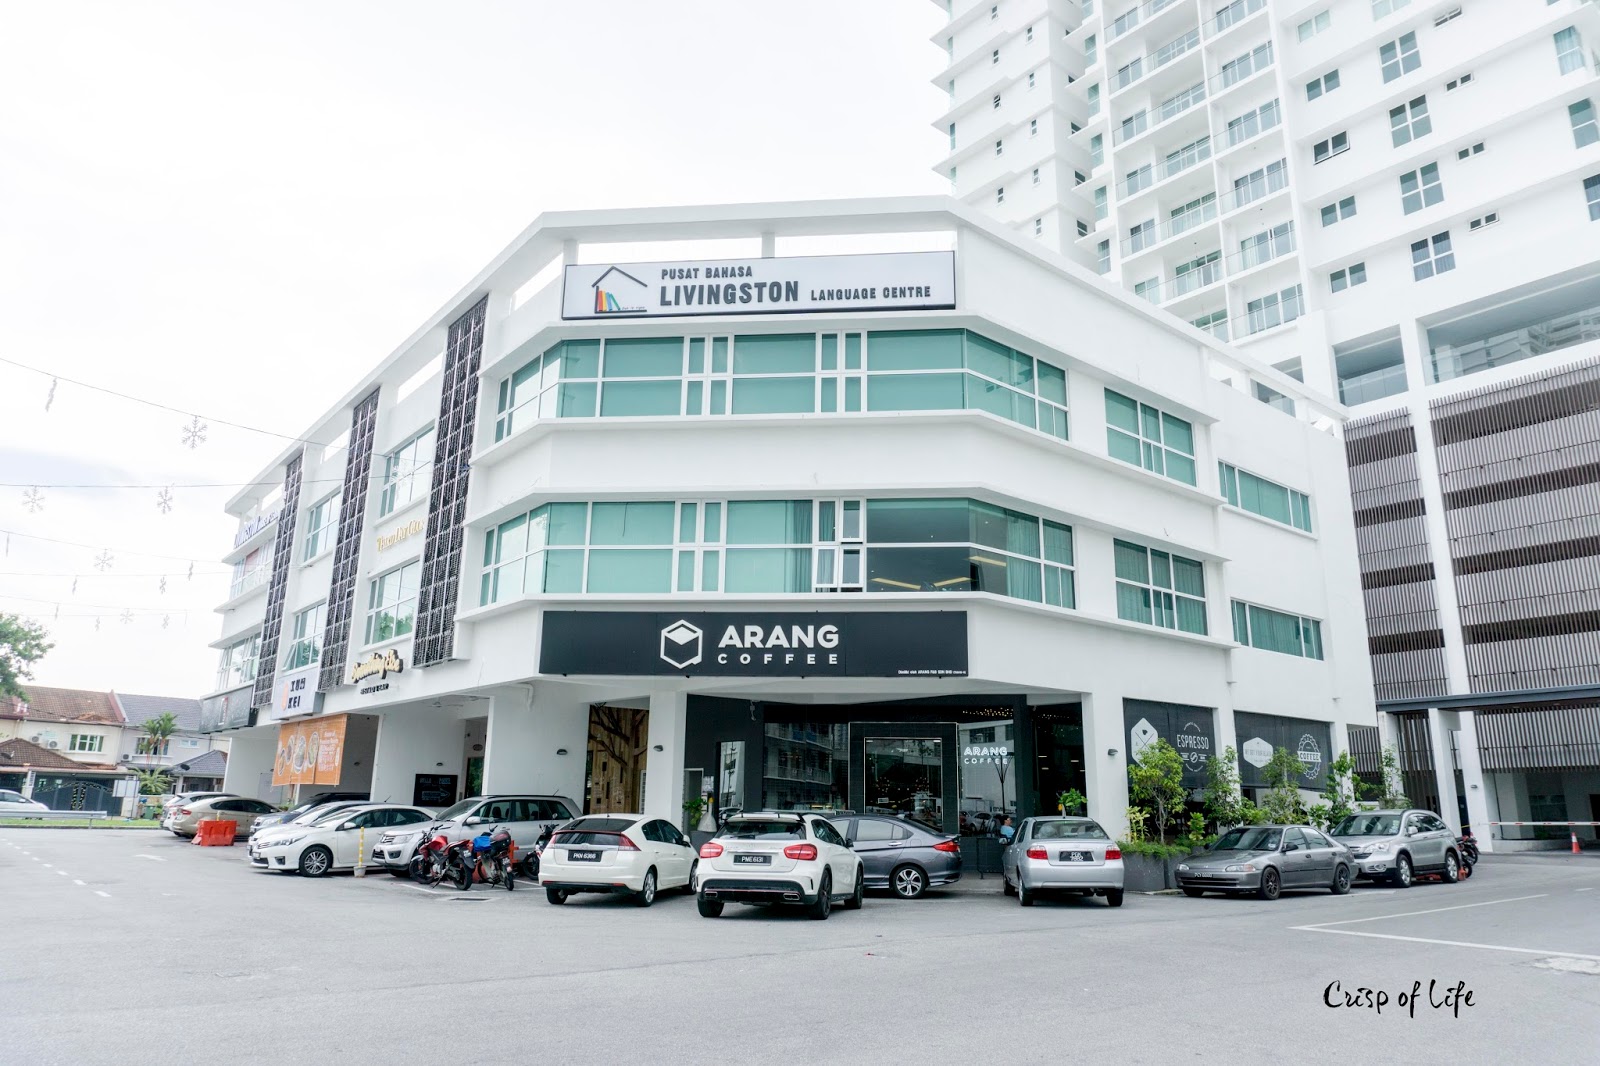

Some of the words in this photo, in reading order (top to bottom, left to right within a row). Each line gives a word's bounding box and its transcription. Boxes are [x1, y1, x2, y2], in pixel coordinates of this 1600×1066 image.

[661, 268, 699, 280] PUSAT
[705, 266, 752, 279] BAHASA
[660, 281, 799, 306] LIVINGSTON
[811, 288, 876, 301] LANGUAGE
[883, 286, 931, 298] CENTRE
[718, 624, 839, 649] ARANG
[717, 653, 838, 665] COFFEE
[1177, 734, 1209, 750] ESPRESSO
[963, 746, 1008, 756] ARANG
[1299, 752, 1319, 761] COFFEE
